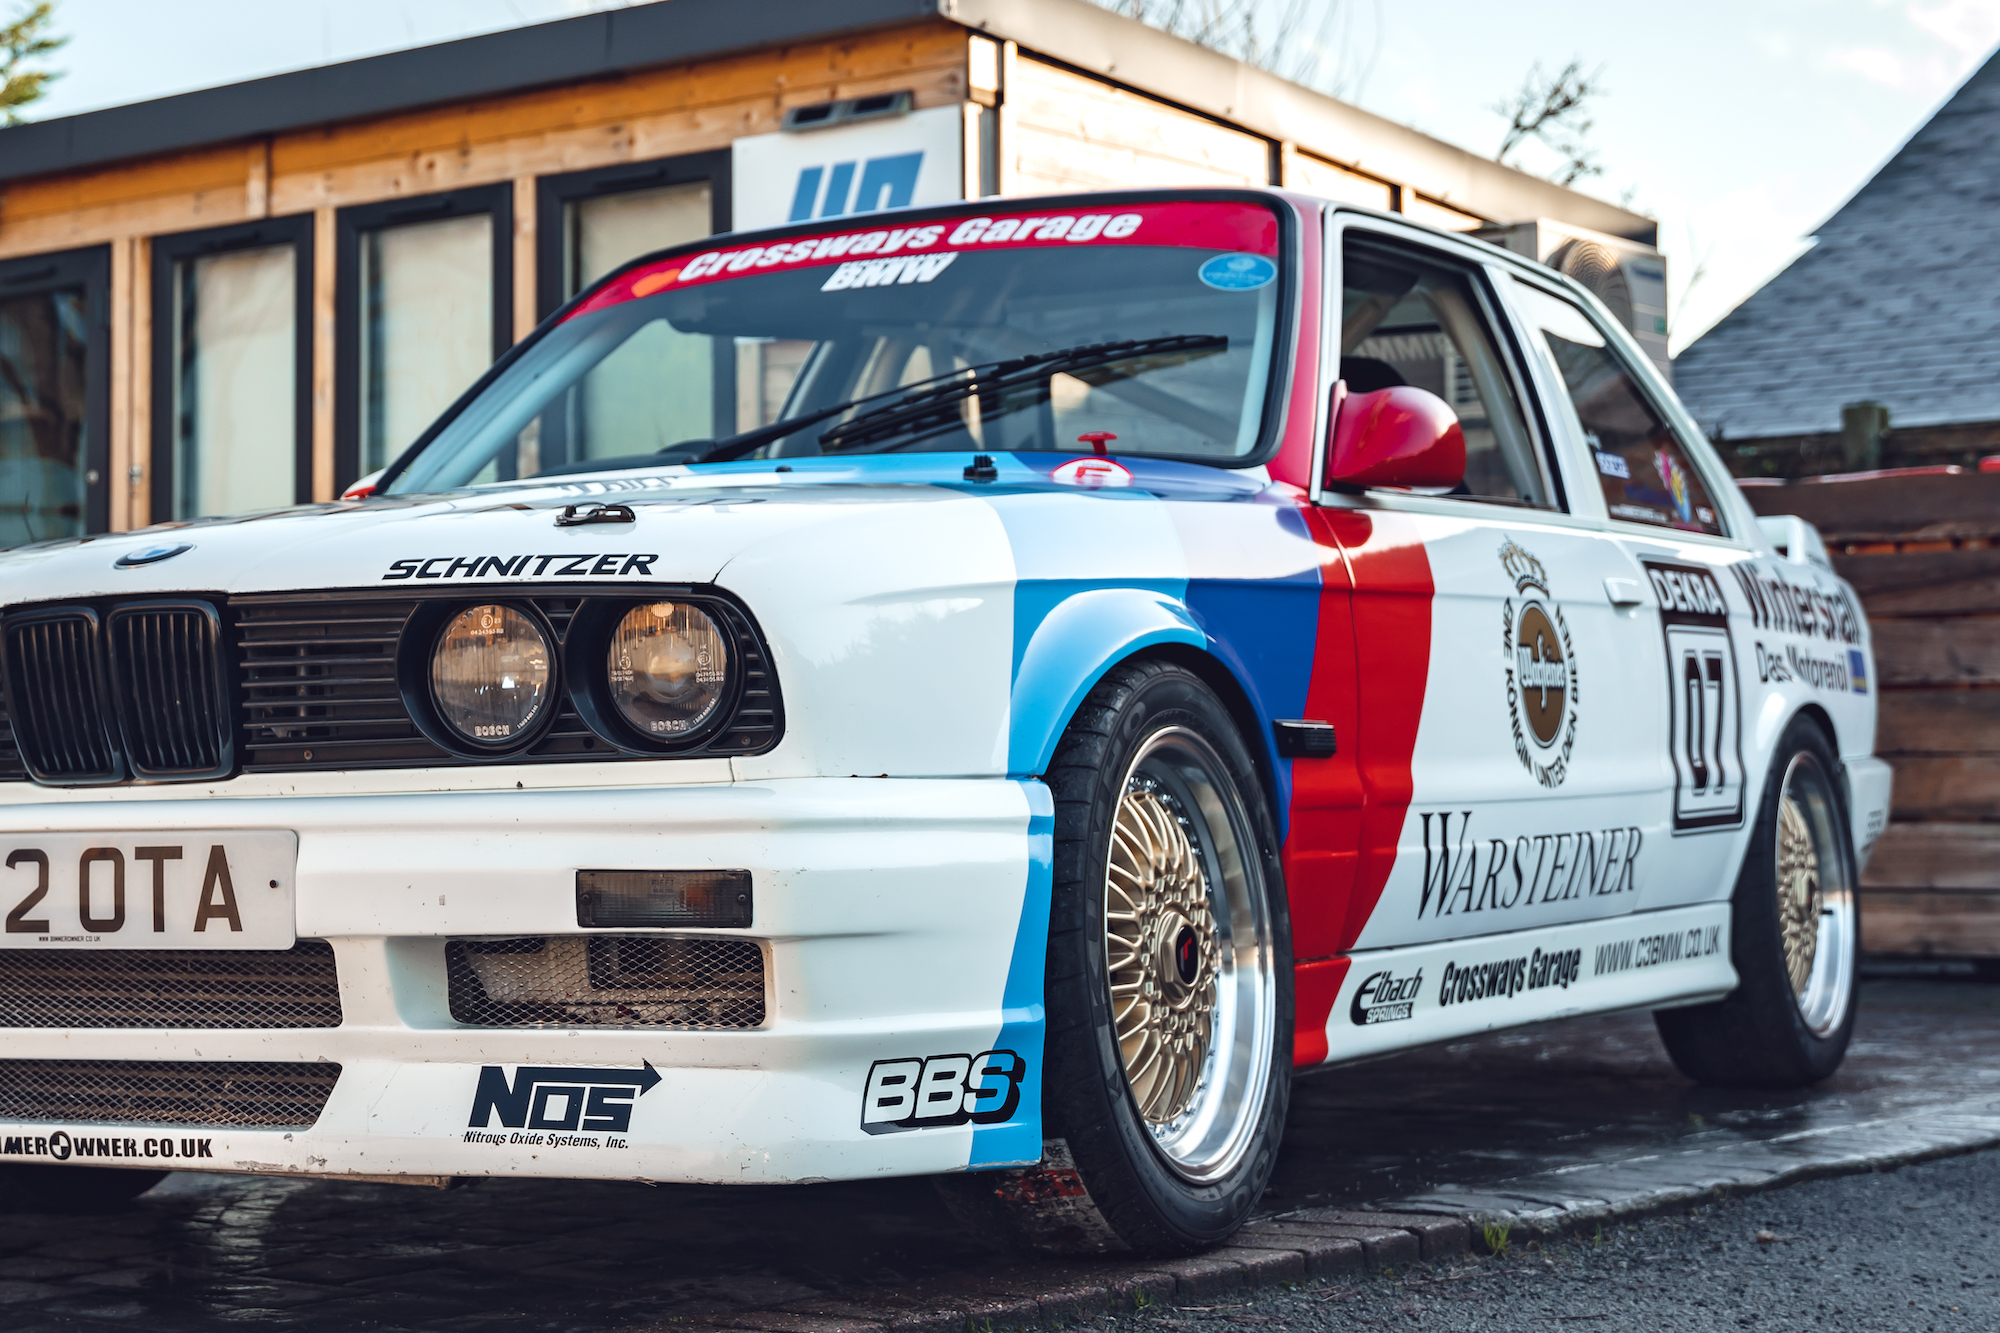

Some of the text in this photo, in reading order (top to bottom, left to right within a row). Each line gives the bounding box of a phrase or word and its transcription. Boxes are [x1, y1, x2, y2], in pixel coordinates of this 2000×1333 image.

[677, 213, 1143, 281] Crossways Garage
[820, 255, 958, 293] BMW
[382, 553, 660, 581] SCHNITZER
[1649, 568, 1726, 615] DEKRA
[1755, 641, 1793, 684] Das
[474, 725, 510, 737] BOSCH
[650, 720, 687, 732] BOSCH
[5, 844, 243, 933] 2 OTA
[1417, 811, 1643, 920] WARSTEINER
[1593, 924, 1720, 976] WWW.C3BMW.CO.UK
[1350, 966, 1423, 1025] Eibach
[1438, 946, 1582, 1006] Crossways Garage
[1365, 1003, 1411, 1024] SPRINGS
[467, 1065, 662, 1133] NOS
[861, 1049, 1026, 1136] BBS
[0, 1130, 213, 1161] MEROWNER.CO.UK
[463, 1130, 629, 1150] Nitrous Oxide Systems, Inc.
